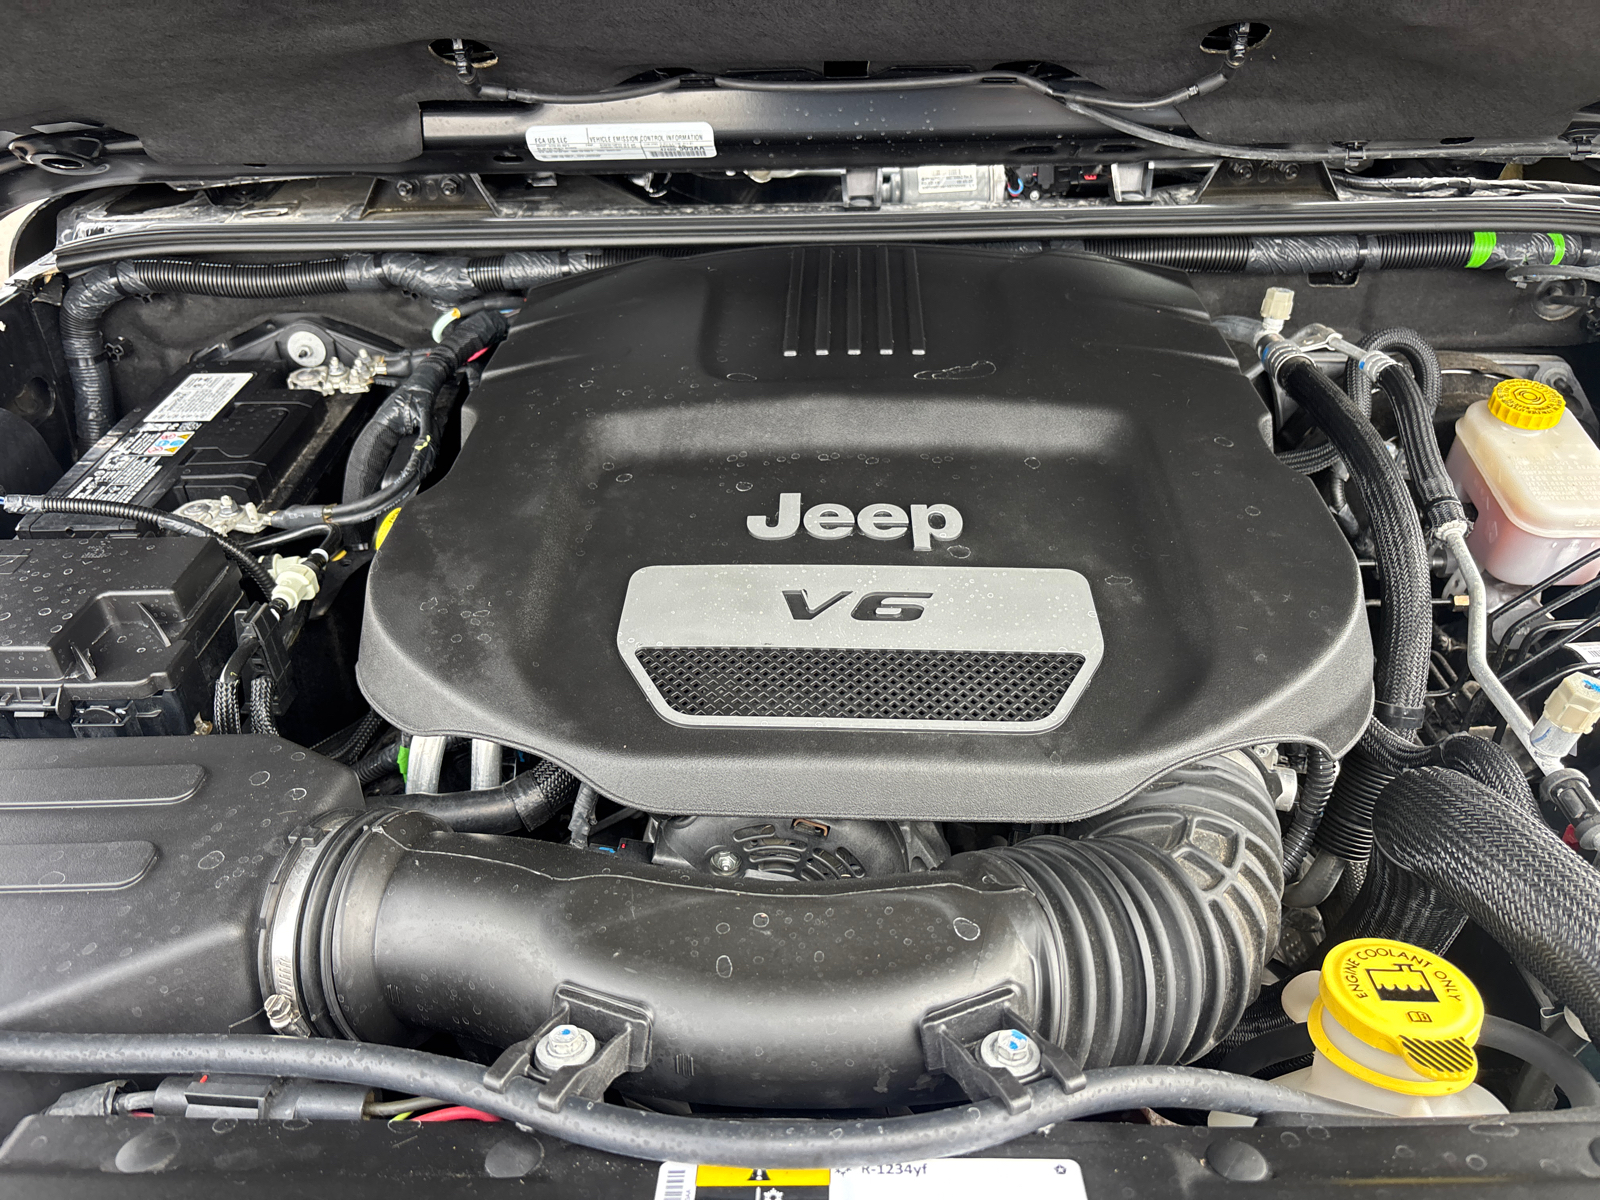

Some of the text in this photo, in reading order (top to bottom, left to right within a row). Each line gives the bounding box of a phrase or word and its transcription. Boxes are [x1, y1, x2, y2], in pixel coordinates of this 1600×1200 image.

[746, 492, 963, 551] Jeep
[781, 588, 934, 622] V6
[1346, 948, 1461, 1002] ENGINE COOLANT ONLY
[862, 1163, 928, 1177] R-1234yf
